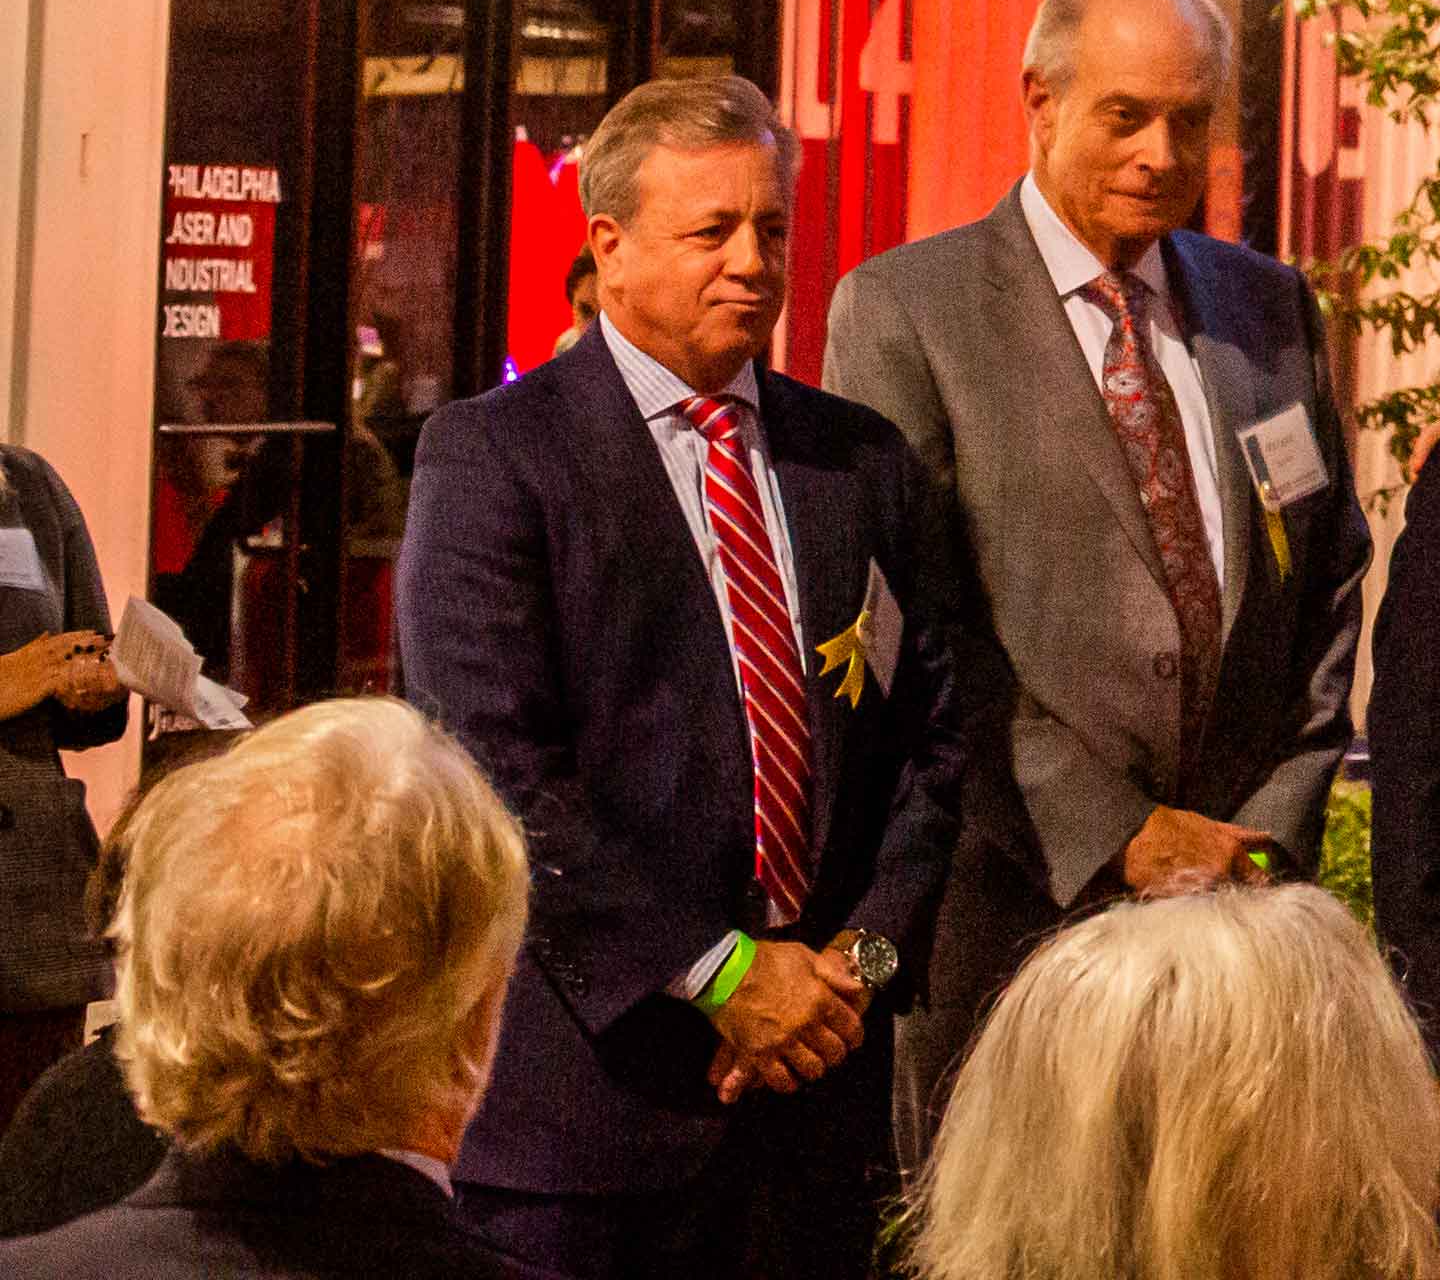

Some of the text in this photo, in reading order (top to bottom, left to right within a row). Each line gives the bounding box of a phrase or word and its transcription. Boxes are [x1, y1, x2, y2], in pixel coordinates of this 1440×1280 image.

[166, 212, 253, 246] ASER AND
[165, 258, 256, 292] NDUSTRIAL
